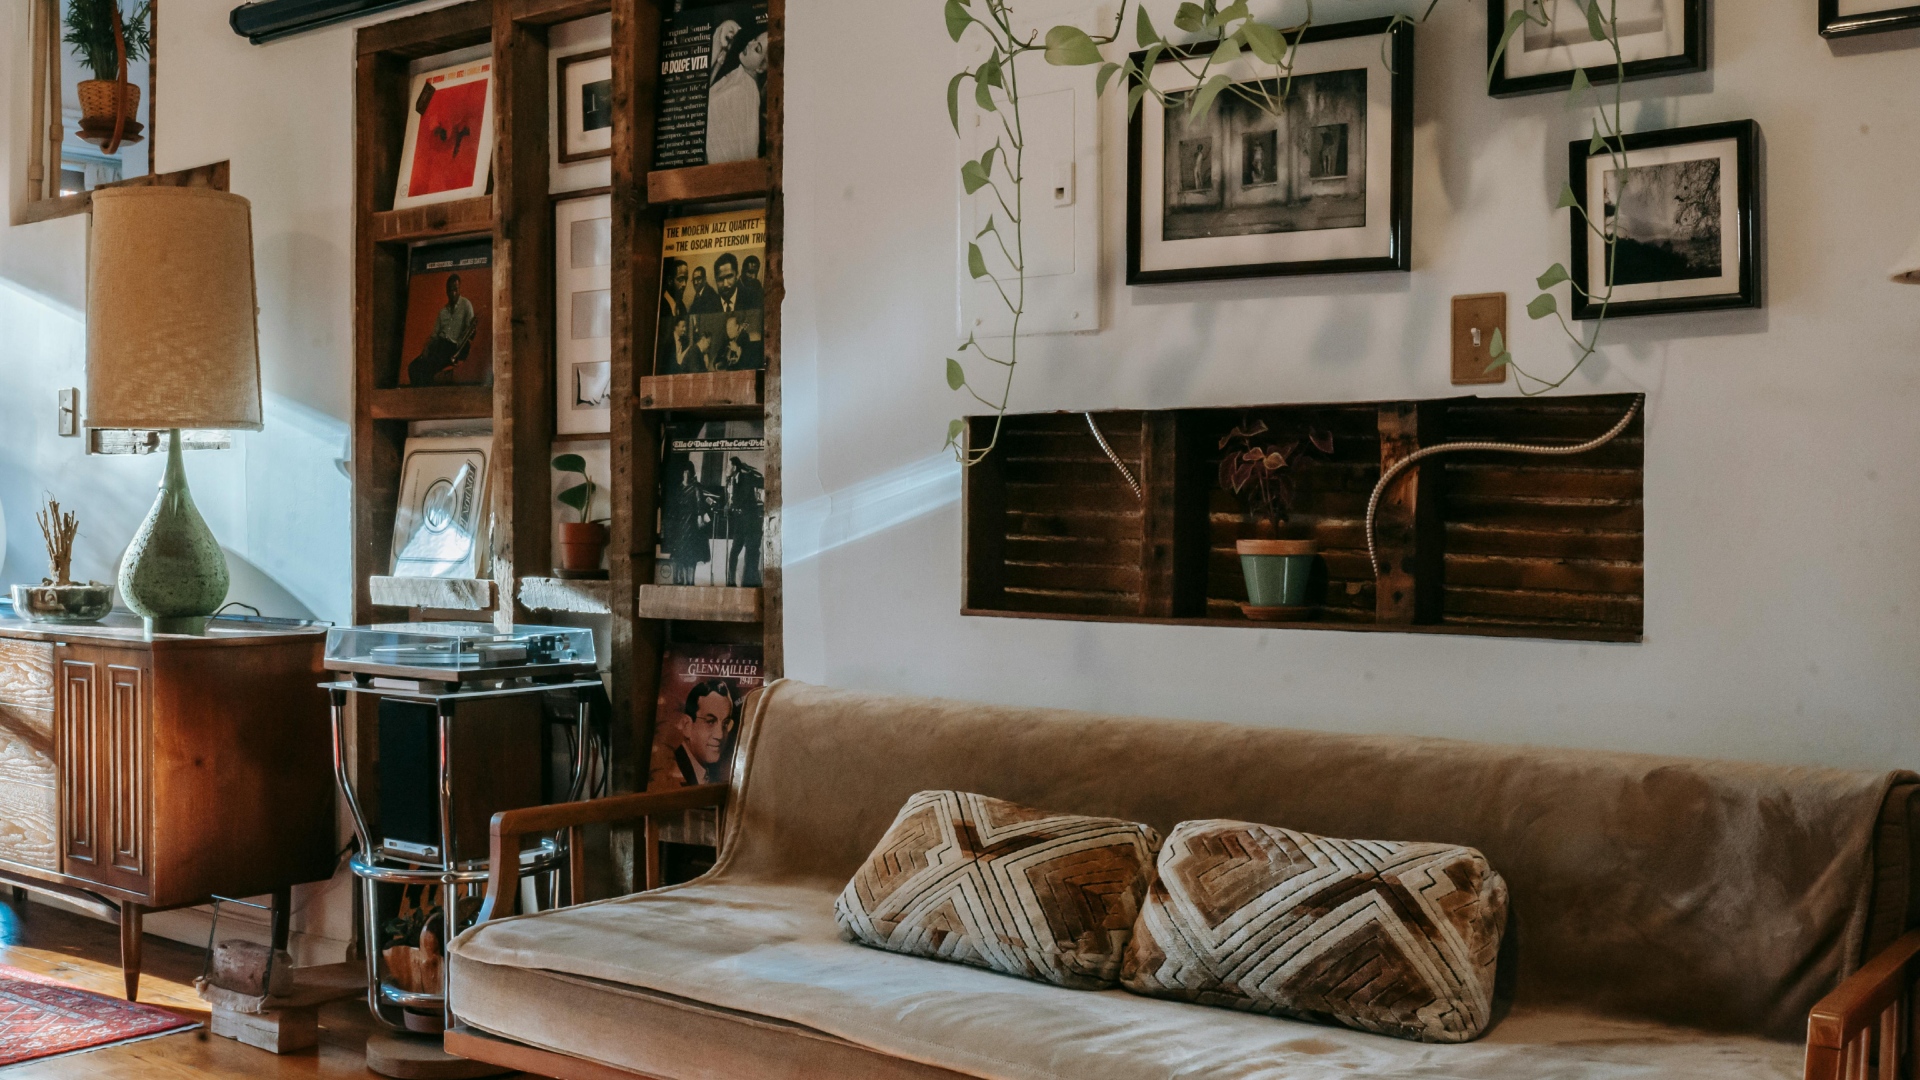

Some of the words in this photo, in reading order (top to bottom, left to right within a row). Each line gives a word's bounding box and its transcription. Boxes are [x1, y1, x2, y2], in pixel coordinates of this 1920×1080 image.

[665, 26, 688, 37] riginal
[661, 62, 669, 75] LA
[669, 58, 690, 74] DOLCE
[691, 55, 708, 71] VITA
[667, 227, 679, 238] THE
[681, 224, 709, 237] MODERN
[711, 222, 726, 234] JAZZ
[729, 218, 760, 233] QUARTET
[676, 240, 688, 252] THE
[690, 238, 712, 250] OSCAR
[715, 234, 749, 248] PETERSON
